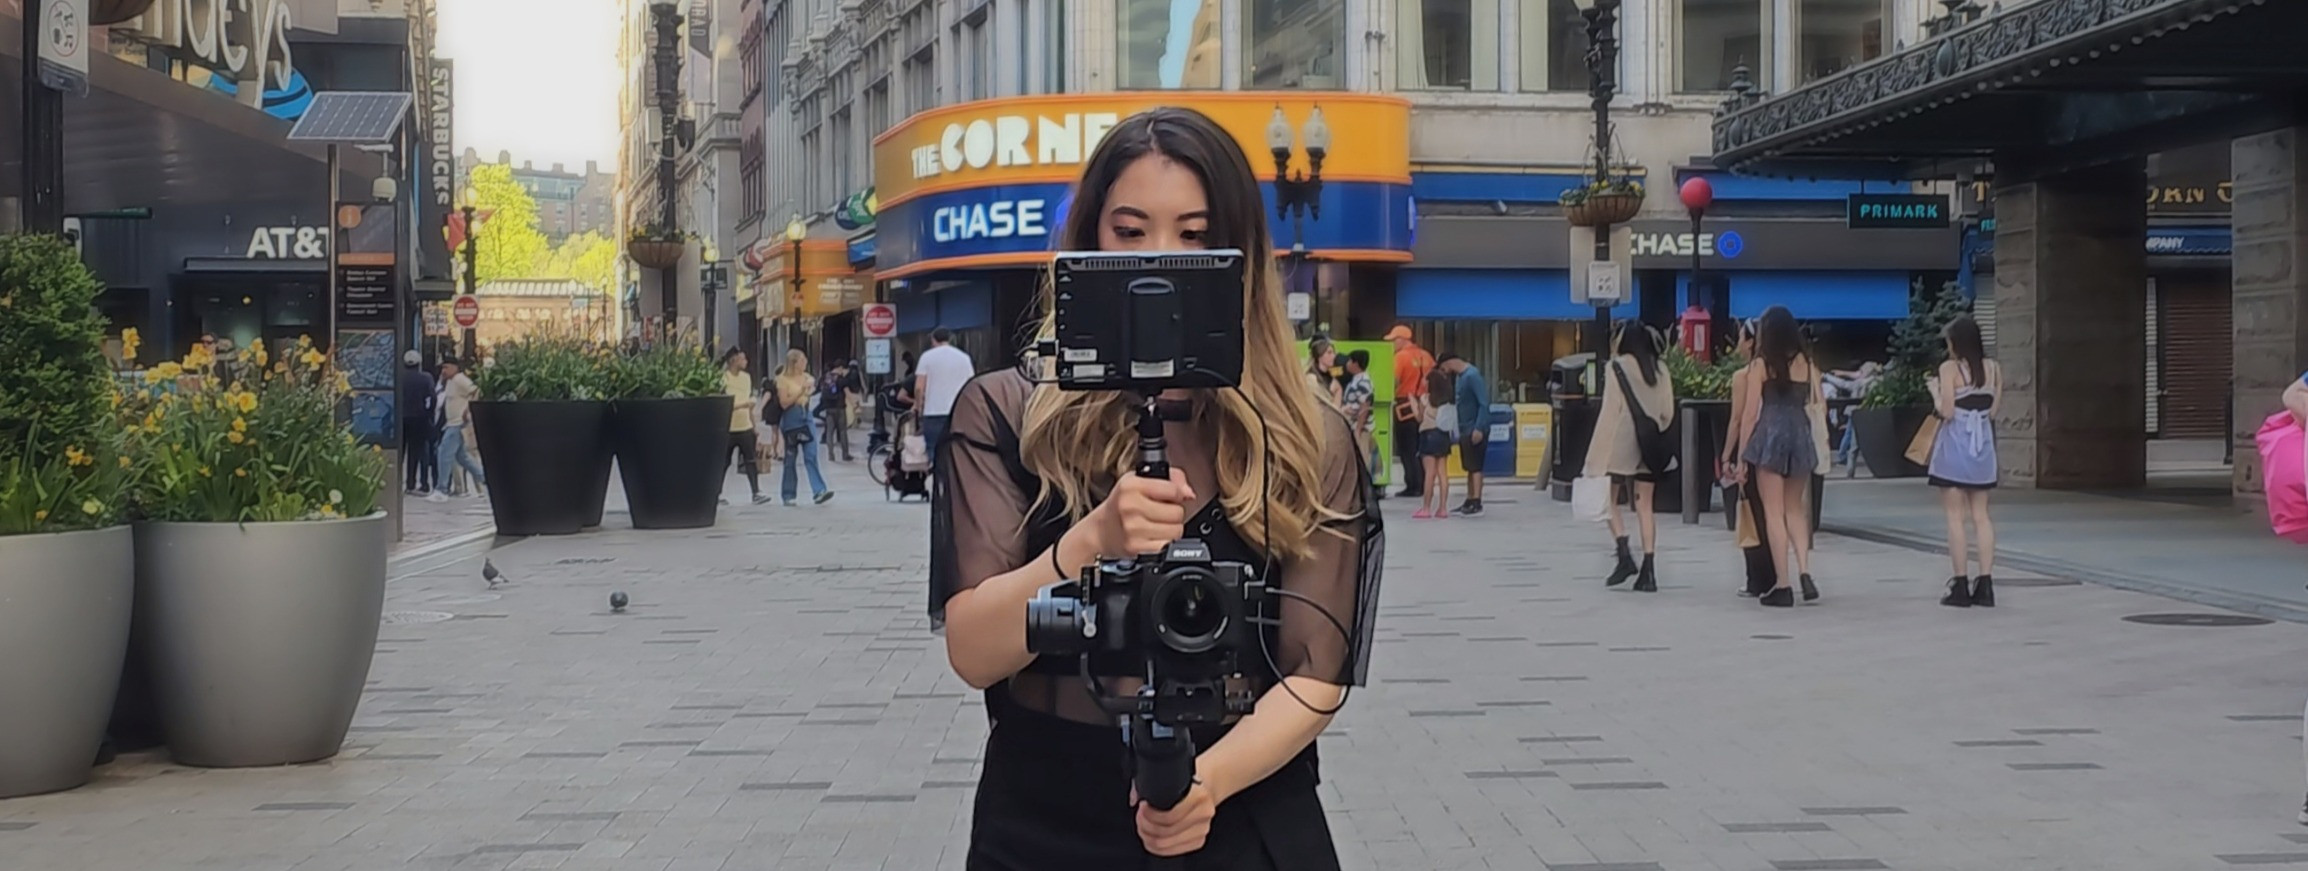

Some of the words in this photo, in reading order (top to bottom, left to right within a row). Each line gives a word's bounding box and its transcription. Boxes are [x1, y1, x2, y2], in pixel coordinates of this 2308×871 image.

[432, 68, 450, 205] STARBUCKS
[911, 144, 941, 179] THE
[941, 113, 1117, 171] CORNE
[934, 200, 1047, 242] CHASE
[1860, 204, 1938, 218] PRIMARK
[1173, 549, 1203, 557] SONY
